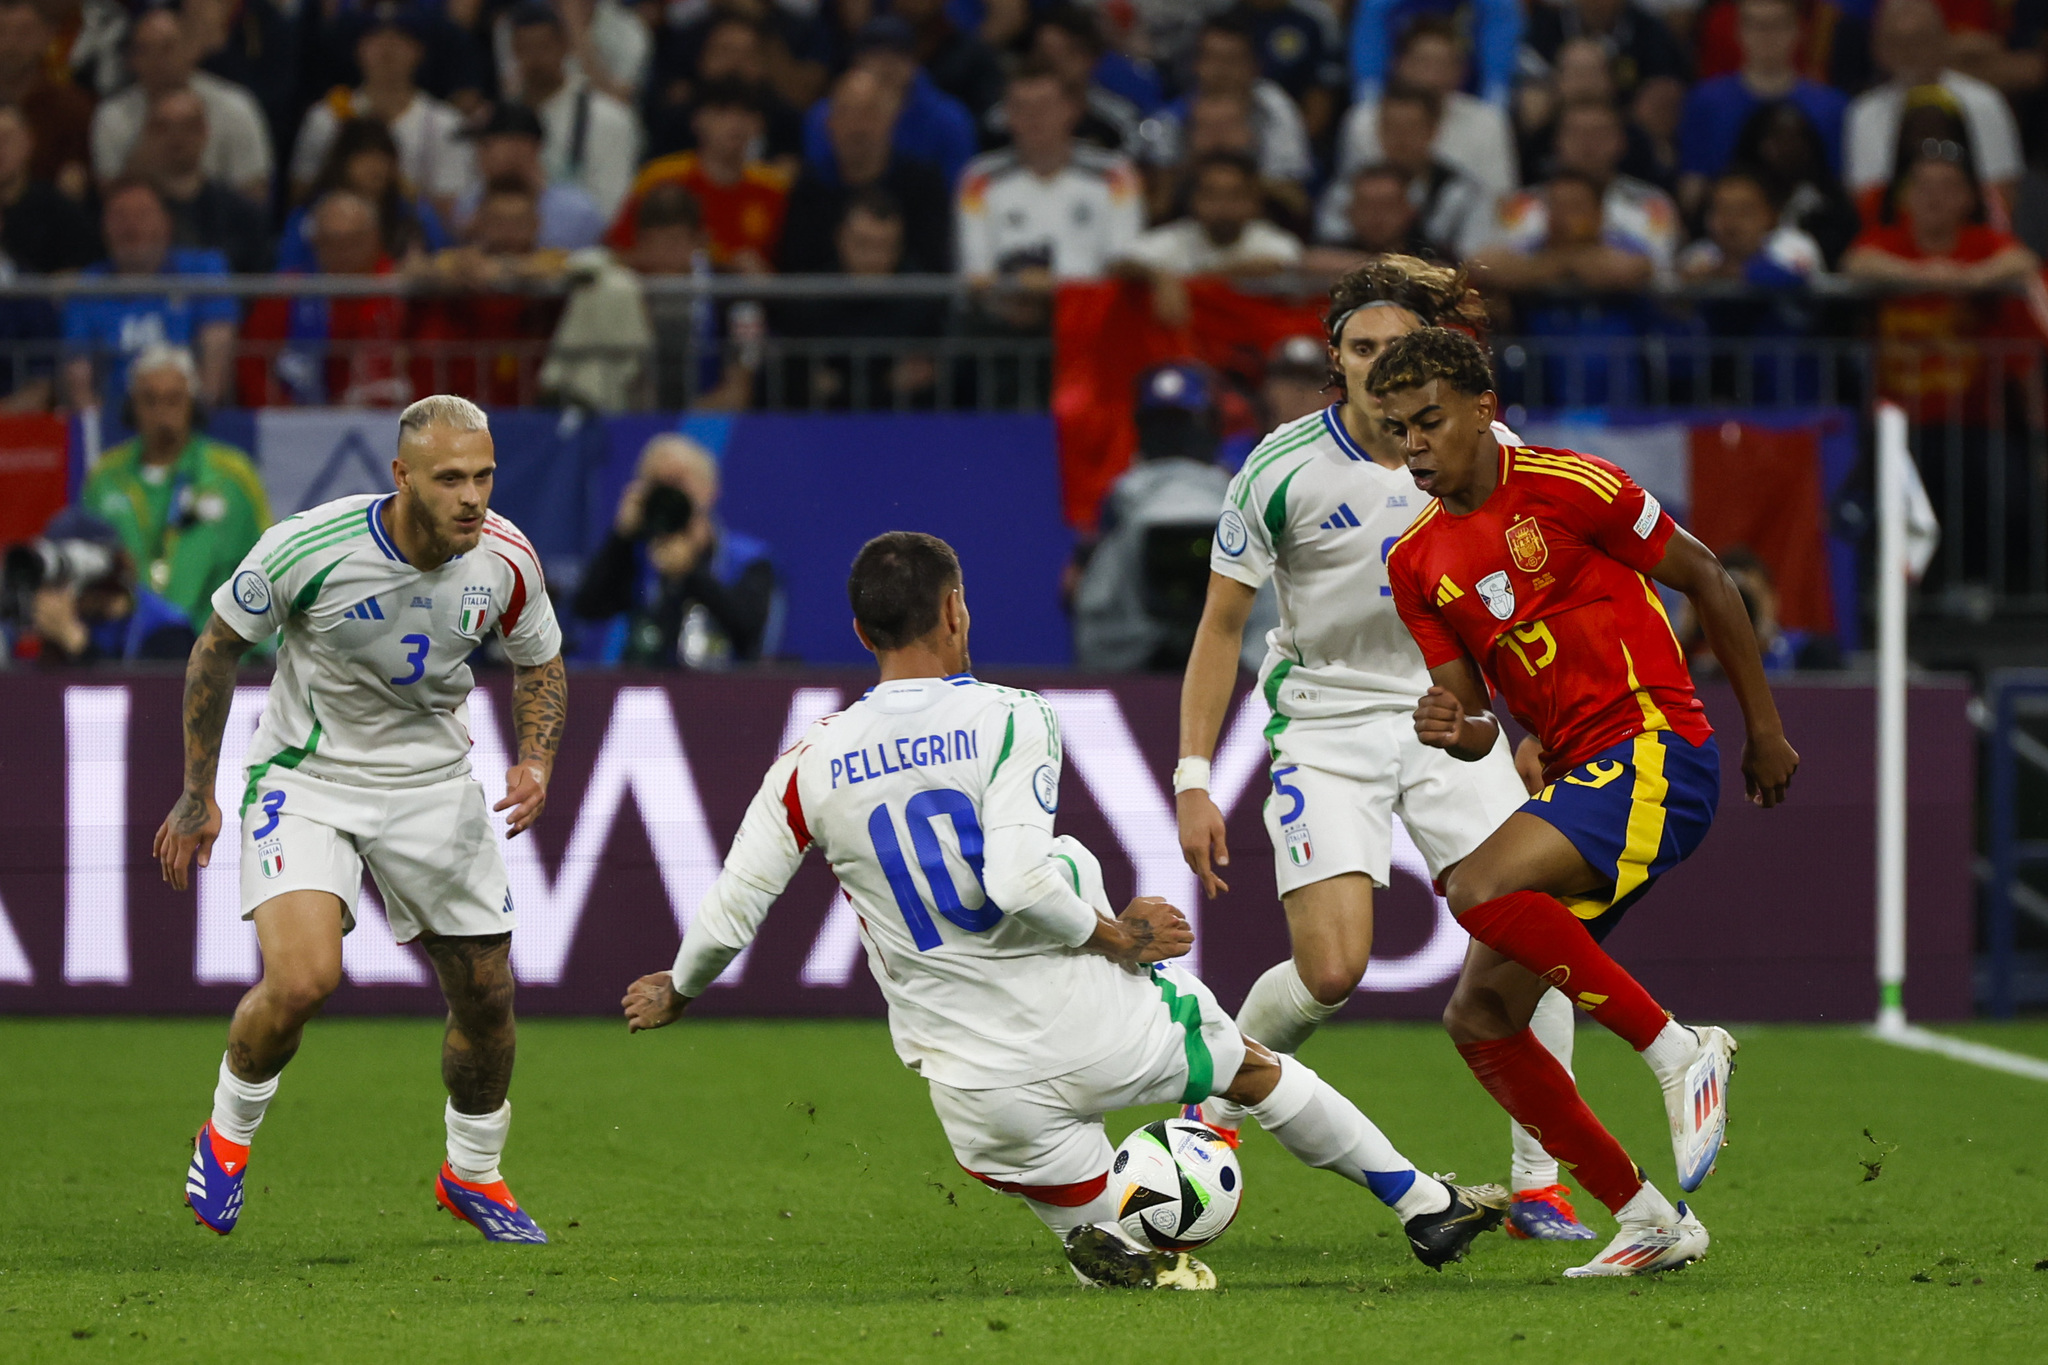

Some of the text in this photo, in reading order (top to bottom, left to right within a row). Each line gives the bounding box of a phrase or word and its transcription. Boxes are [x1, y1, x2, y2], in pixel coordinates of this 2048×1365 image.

[464, 597, 488, 606] ITALIA
[390, 633, 430, 685] 3
[1495, 620, 1557, 677] 19
[830, 729, 978, 789] PELLEGRINI
[1557, 759, 1624, 789] 9
[252, 789, 287, 841] 3
[1272, 766, 1305, 826] 5
[260, 846, 280, 857] ITALIA
[868, 788, 1004, 953] 10
